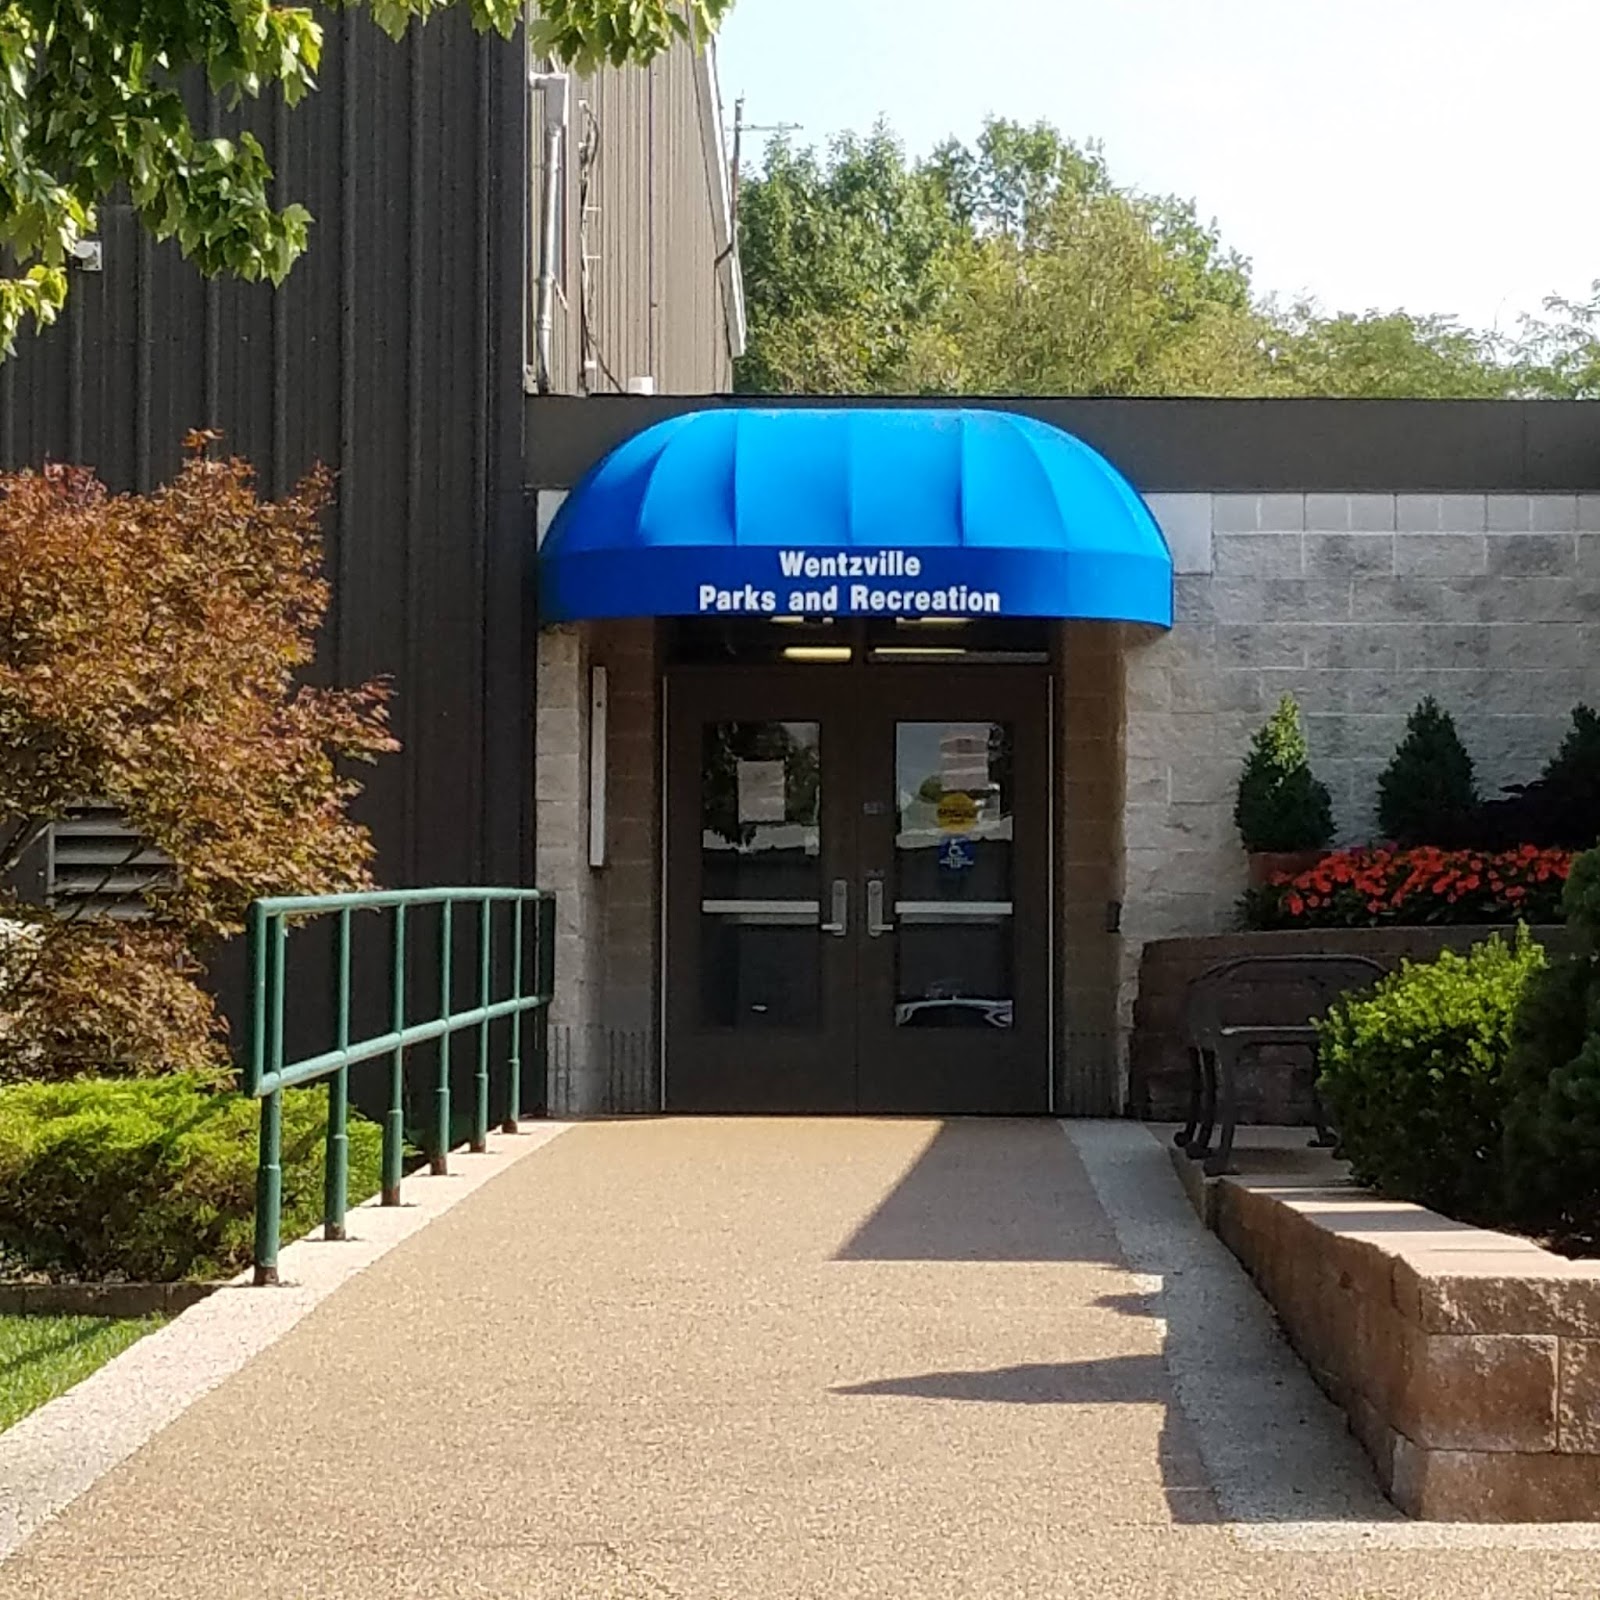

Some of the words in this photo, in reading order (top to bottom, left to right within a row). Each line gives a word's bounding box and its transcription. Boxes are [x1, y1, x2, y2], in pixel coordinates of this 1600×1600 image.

[779, 550, 921, 578] Wentzville
[699, 584, 776, 612] Parks
[788, 585, 838, 612] and
[850, 584, 1000, 613] Recreation
